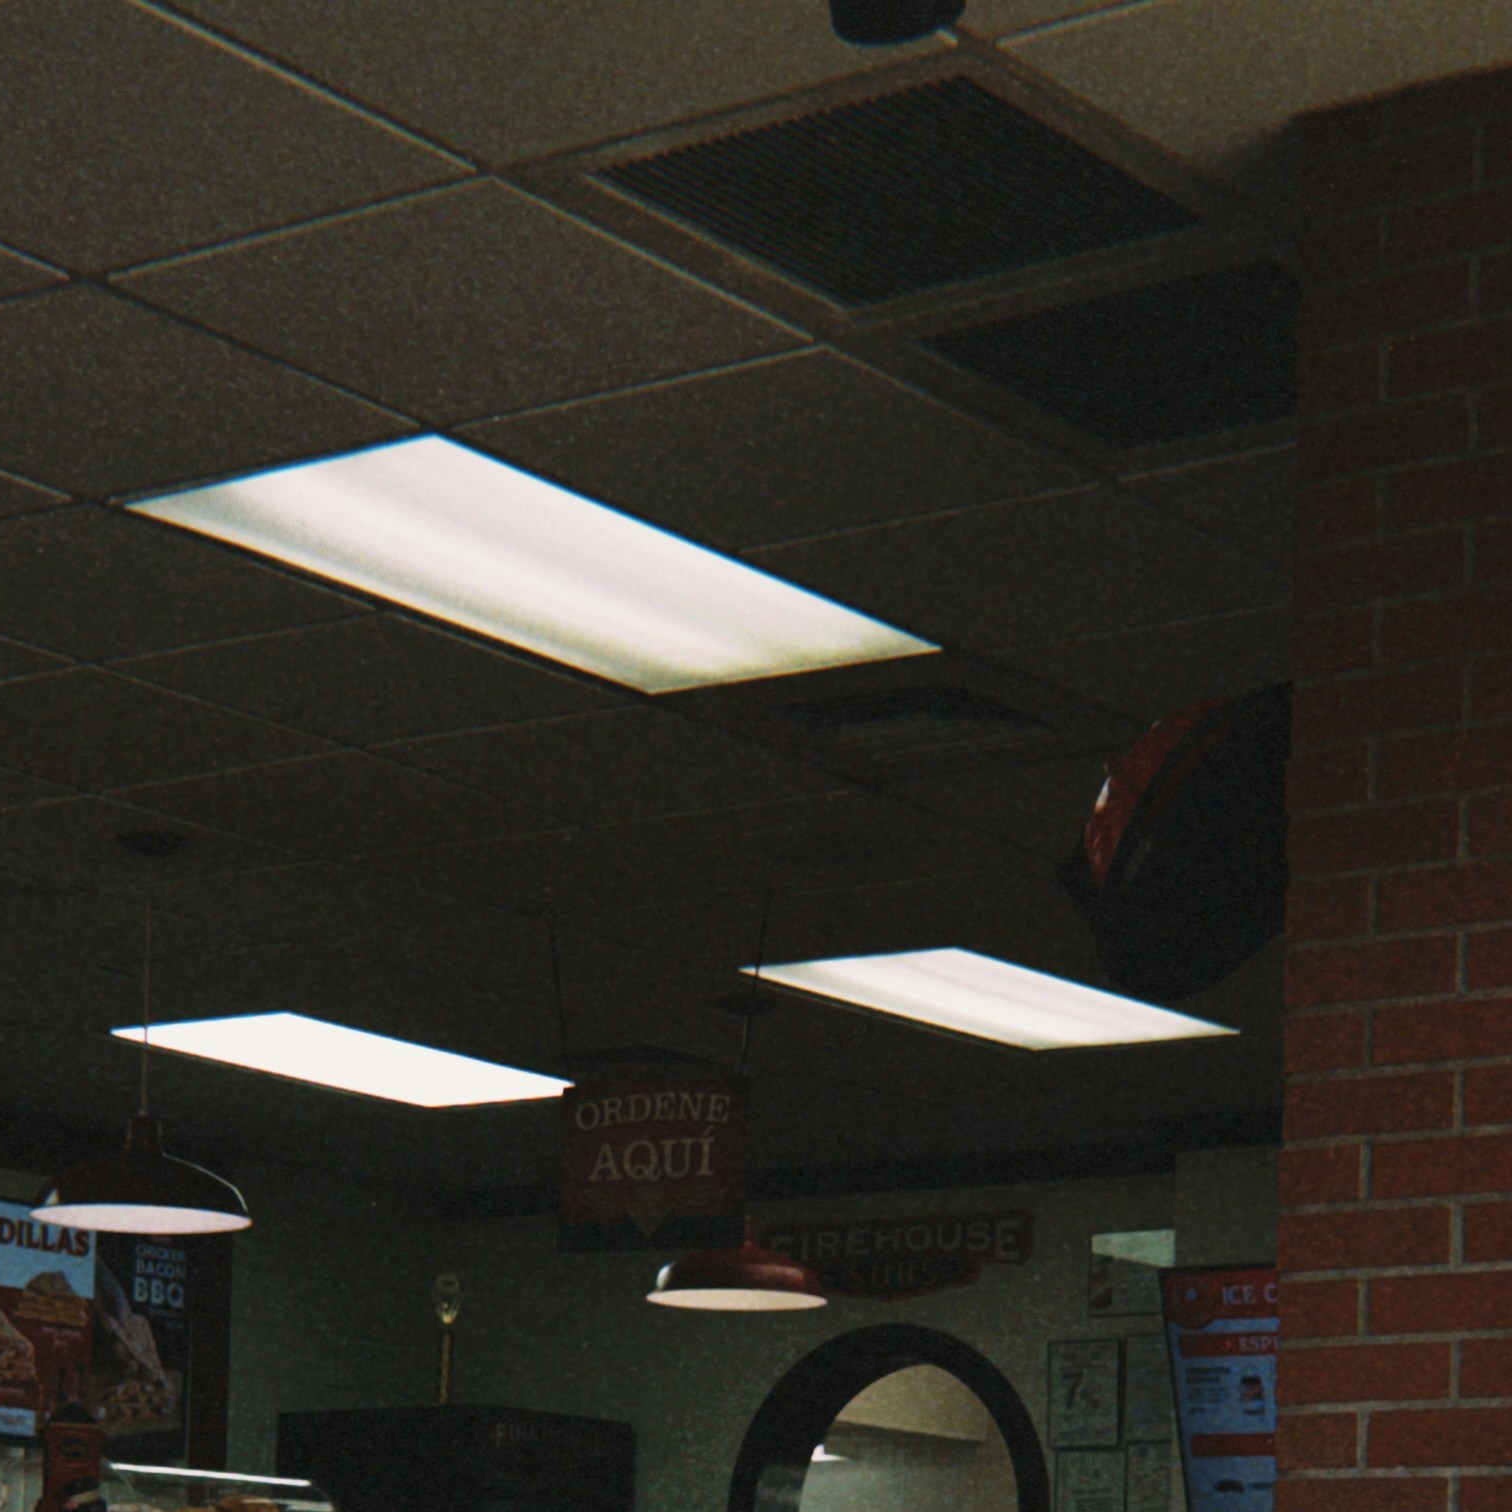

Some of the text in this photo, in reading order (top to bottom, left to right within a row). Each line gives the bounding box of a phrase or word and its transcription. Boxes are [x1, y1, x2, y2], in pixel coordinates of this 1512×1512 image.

[575, 1091, 732, 1131] ORDENE
[588, 1121, 717, 1184] AQUÍ
[769, 1216, 1024, 1264] FIREHOUSE
[136, 1258, 187, 1281] BACON
[133, 1276, 185, 1309] BBQ
[1222, 1285, 1257, 1305] ICE
